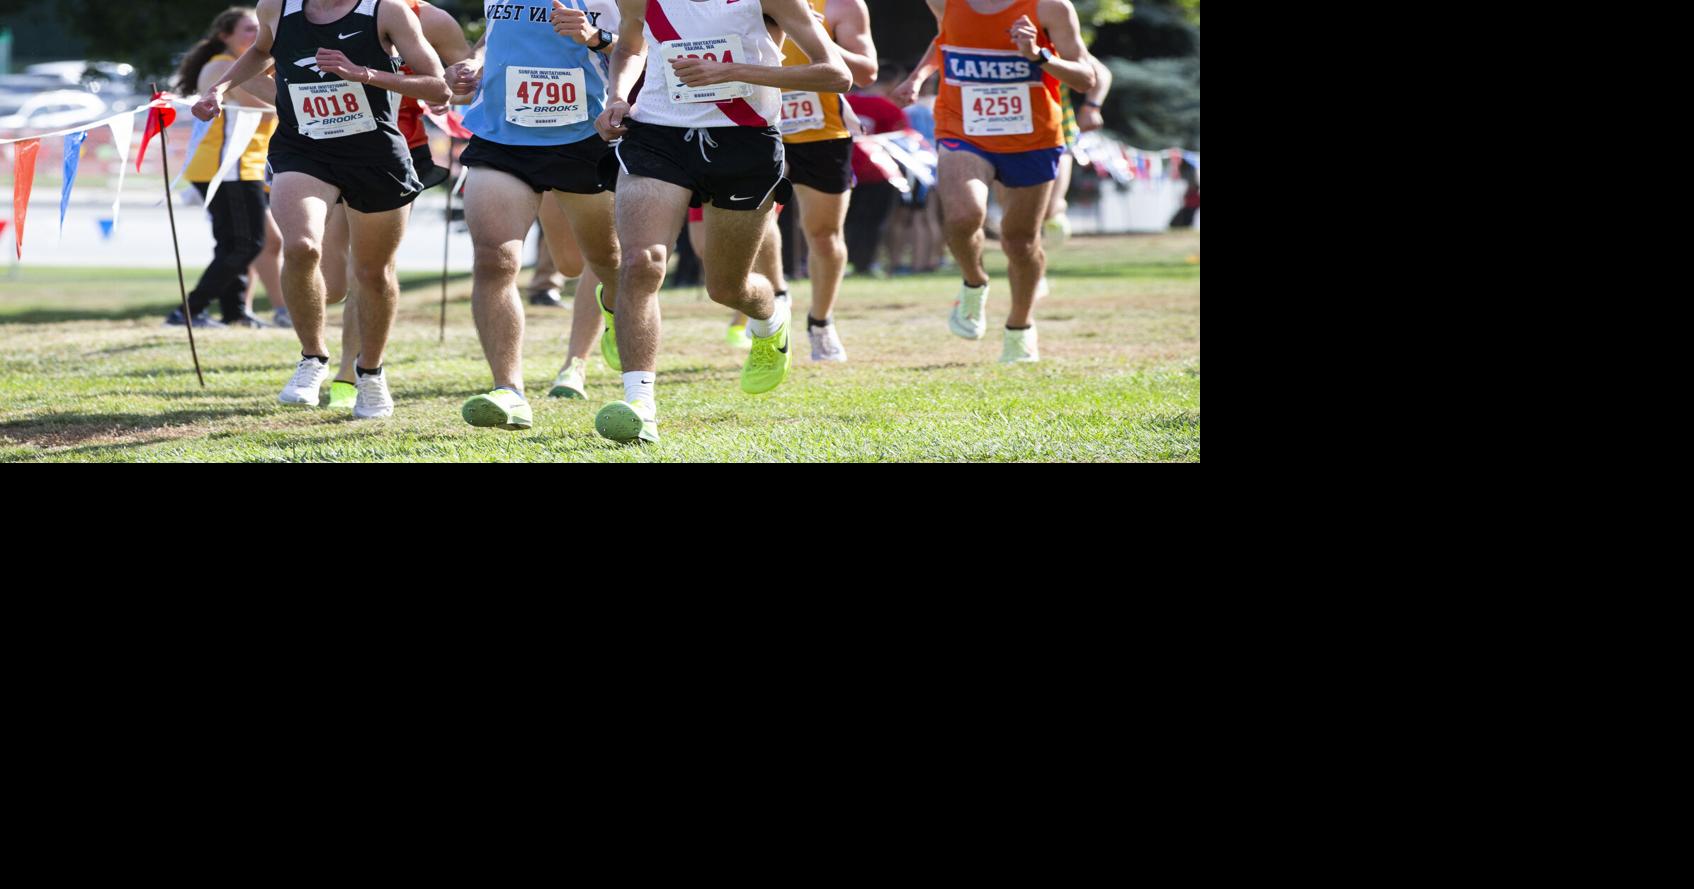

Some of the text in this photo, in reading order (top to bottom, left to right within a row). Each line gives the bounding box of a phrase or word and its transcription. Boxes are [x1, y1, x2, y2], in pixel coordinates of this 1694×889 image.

[529, 7, 601, 26] VAY
[950, 59, 1031, 79] LAKES
[517, 81, 576, 104] 4790
[303, 93, 359, 118] 4018
[780, 100, 814, 120] 179
[973, 96, 1022, 116] 4259
[323, 112, 363, 125] BROOKS
